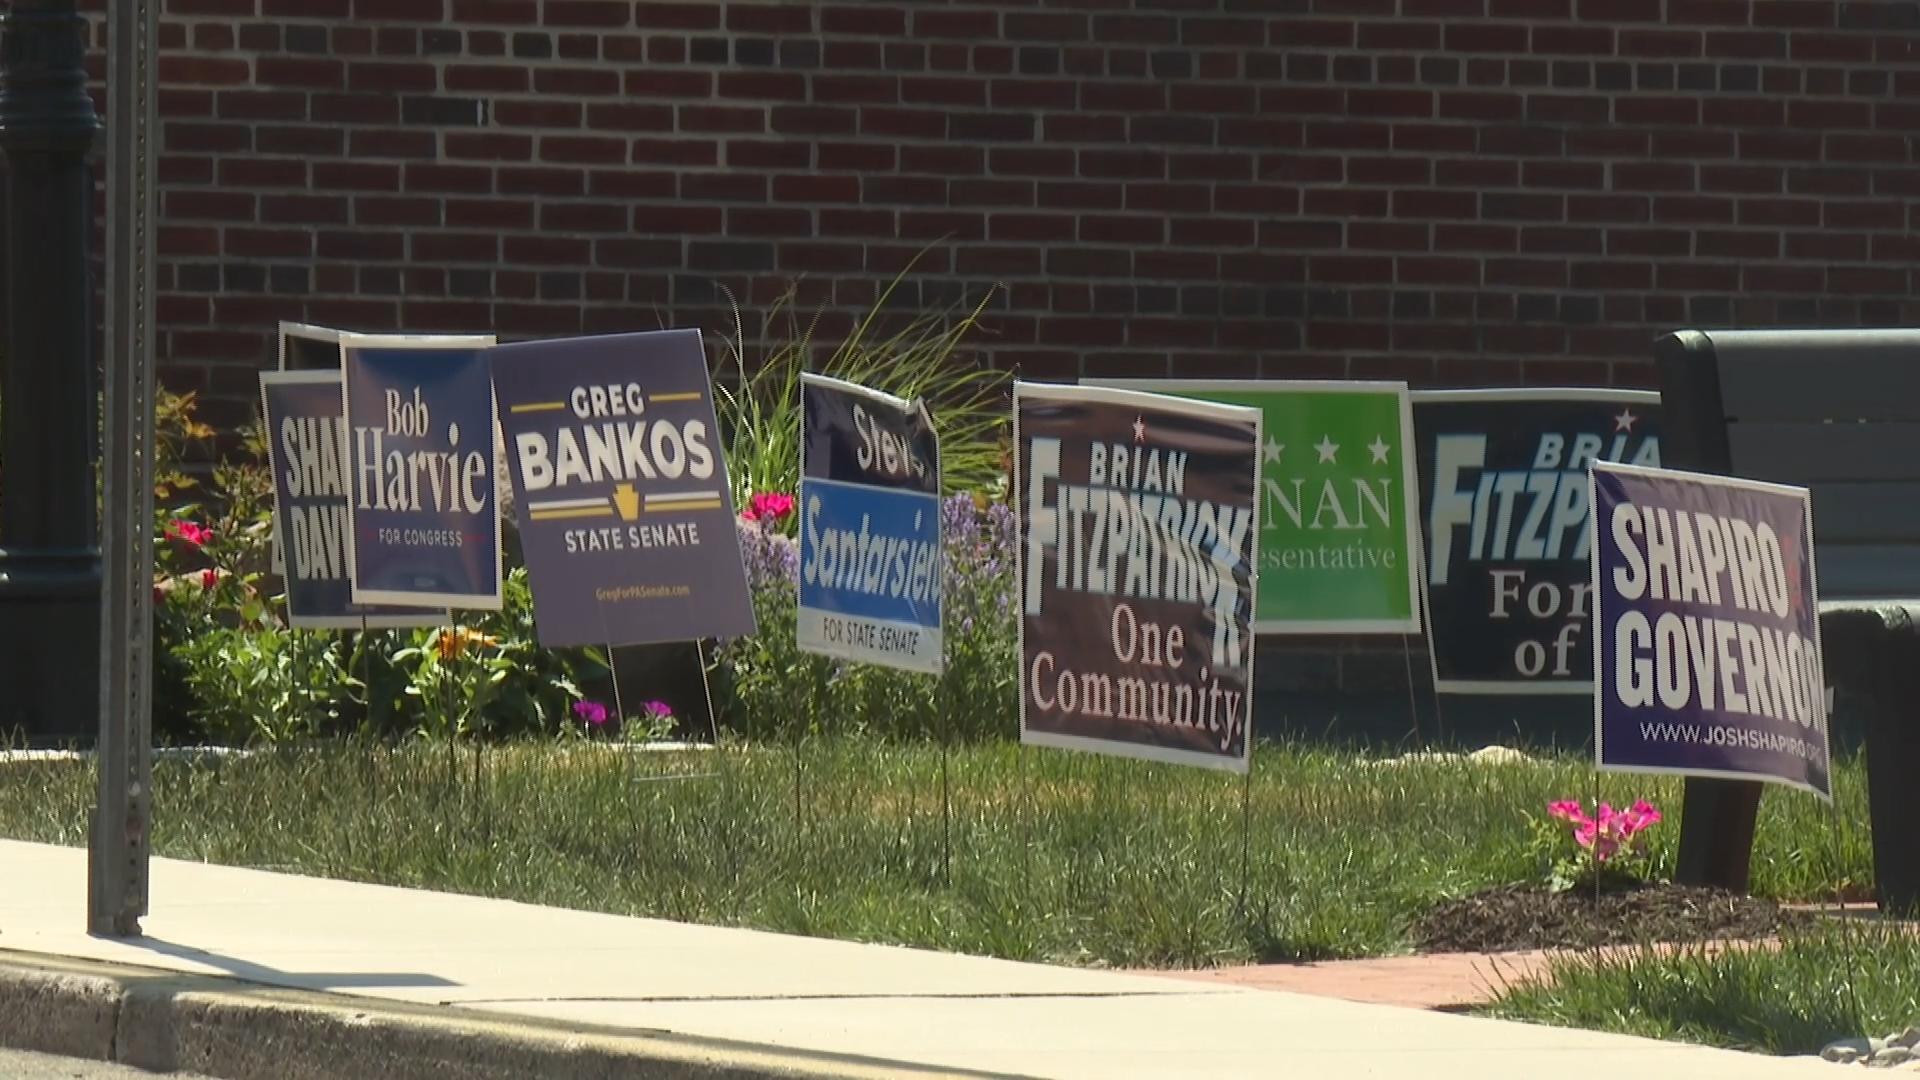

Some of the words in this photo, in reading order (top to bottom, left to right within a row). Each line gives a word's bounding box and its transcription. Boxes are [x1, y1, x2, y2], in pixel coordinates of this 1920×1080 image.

[386, 386, 429, 437] Bob
[570, 382, 645, 419] GREG
[354, 422, 487, 514] Harvie
[515, 418, 714, 492] BANKOS
[1090, 440, 1188, 496] BRIAN
[1263, 477, 1392, 530] NAN
[378, 529, 401, 545] FOR
[404, 529, 463, 547] CONGRESS
[564, 527, 624, 553] STATE
[630, 523, 700, 549] SENATE
[1025, 437, 1251, 668] FITZPATRICK
[1611, 502, 1789, 618] SHAPIRO
[823, 616, 843, 643] FOR
[847, 621, 875, 650] STATE
[879, 626, 920, 656] SENATE
[1111, 603, 1185, 669] One
[1514, 623, 1581, 676] of
[1031, 651, 1242, 751] Community.
